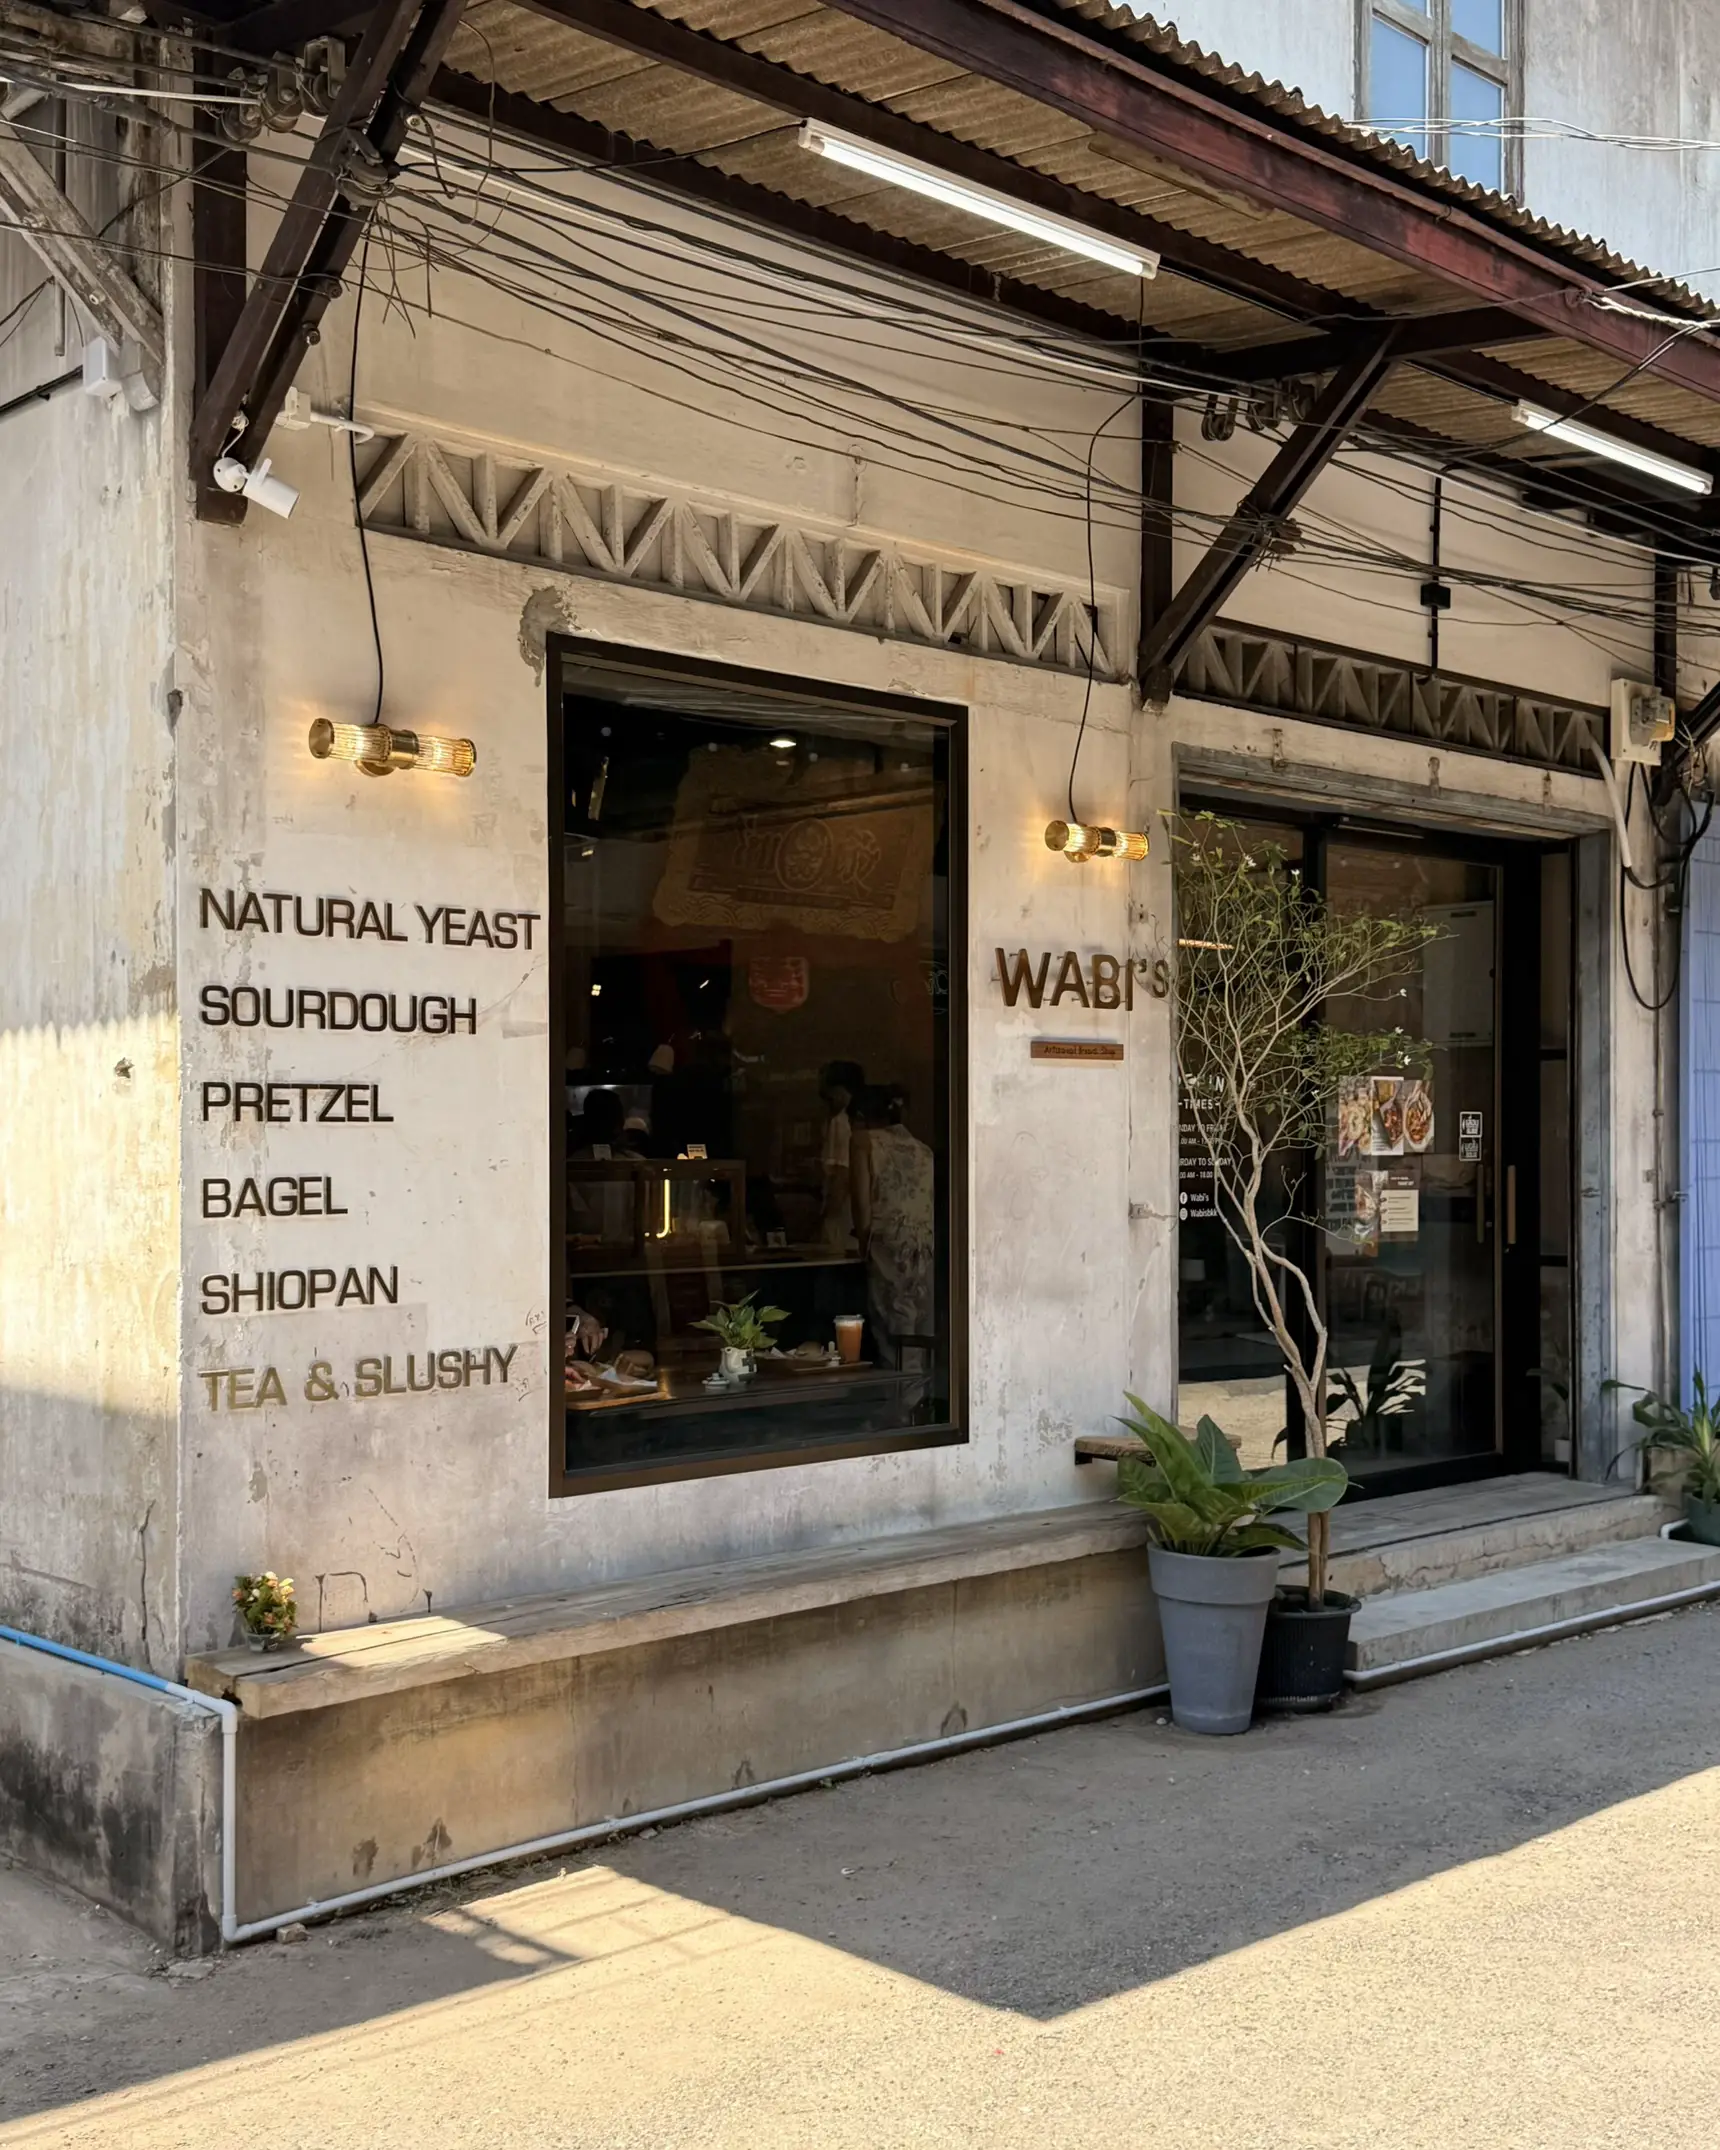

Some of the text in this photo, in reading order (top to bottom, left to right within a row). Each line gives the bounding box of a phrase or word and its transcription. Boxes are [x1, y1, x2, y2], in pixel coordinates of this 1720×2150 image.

[200, 888, 541, 951] NATURAL YEAST
[200, 984, 477, 1035] SOURDOUGH
[201, 1081, 394, 1122] PRETZEL
[1198, 1157, 1207, 1166] TO
[1208, 1157, 1231, 1167] SDAY
[201, 1176, 348, 1219] BAGEL
[201, 1265, 399, 1316] SHIOPAN
[198, 1366, 288, 1412] TEA
[303, 1359, 339, 1401] &
[354, 1344, 519, 1398] SLUSHY
